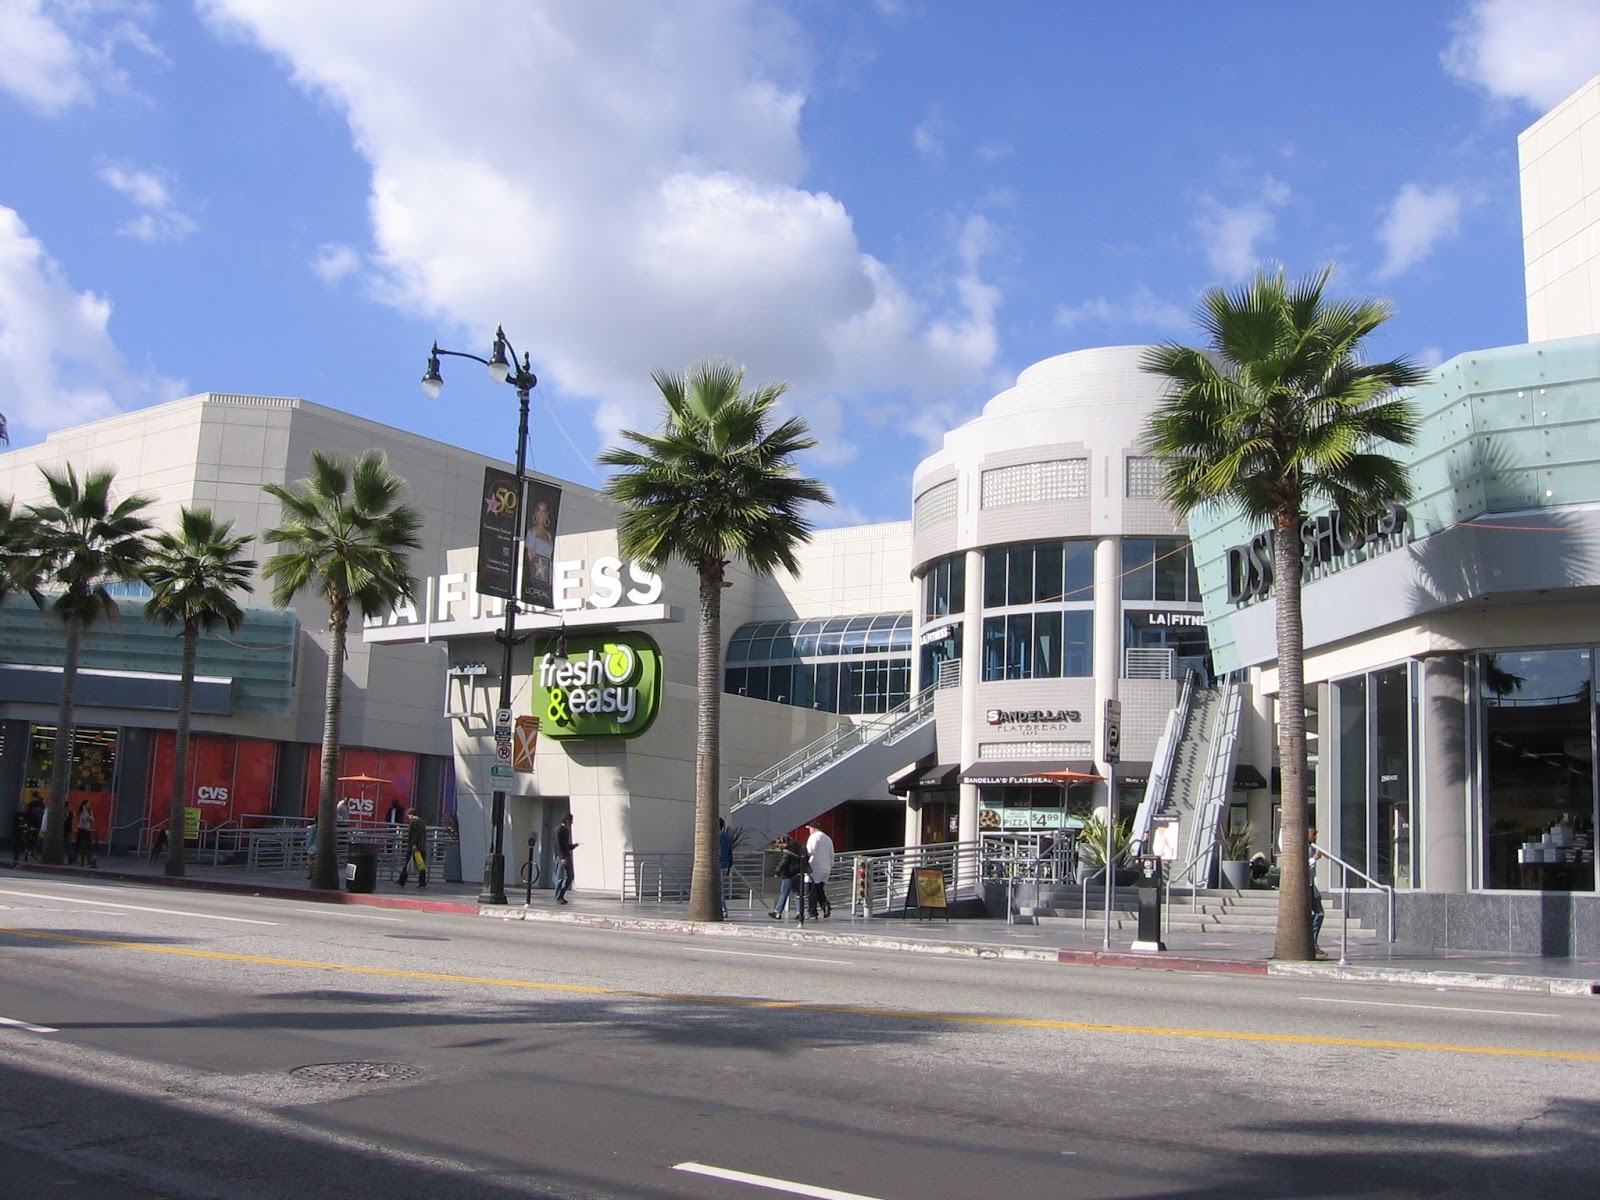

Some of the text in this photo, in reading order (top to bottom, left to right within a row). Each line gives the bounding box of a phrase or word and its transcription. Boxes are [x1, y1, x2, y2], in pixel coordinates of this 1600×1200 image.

[491, 487, 517, 513] 50
[439, 556, 662, 621] FIESS
[1171, 614, 1208, 626] FITNE
[540, 649, 603, 687] fresh
[547, 686, 636, 723] & easy
[987, 709, 1081, 724] SANDELLA'S
[997, 724, 1067, 732] FLATBREAD
[198, 786, 229, 800] CVS
[348, 798, 374, 811] CVS
[1004, 819, 1029, 827] PIZZA
